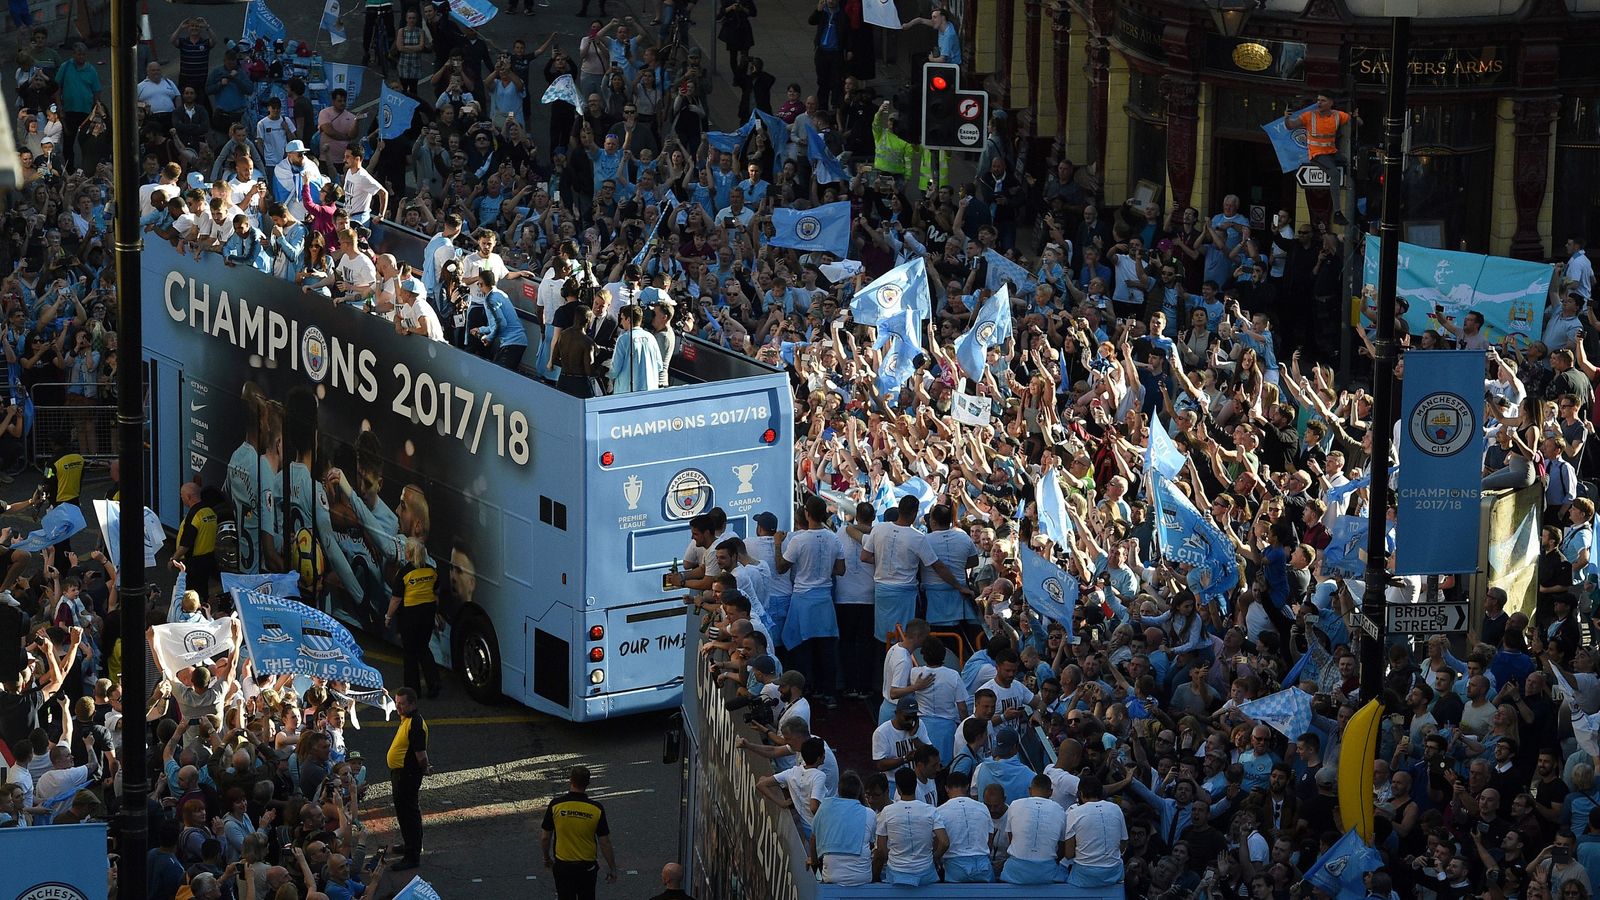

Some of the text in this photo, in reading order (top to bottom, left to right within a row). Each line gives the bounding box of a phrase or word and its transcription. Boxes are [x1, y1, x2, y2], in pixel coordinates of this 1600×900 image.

[1360, 60, 1503, 75] SAERS ARMS
[1310, 171, 1323, 180] WC
[164, 270, 530, 466] CHAMPIONS 2017/18
[1416, 396, 1469, 417] MANCHESTER
[610, 406, 768, 440] CHAMPIONS 2017/18
[1431, 445, 1451, 453] CITY
[671, 470, 706, 490] MANCHESTER
[1401, 488, 1478, 499] CHAMPIONS
[728, 496, 762, 507] CARABAO
[738, 504, 752, 512] CUP
[1415, 500, 1462, 511] 2017/18
[618, 513, 648, 523] PREMIER
[619, 520, 646, 530] LEAGUE
[1177, 547, 1207, 563] CITY
[1394, 606, 1446, 618] BRIDGE
[618, 638, 650, 656] OUR
[262, 657, 380, 682] THE CITY IS OURS!
[696, 639, 756, 839] CHAMPIONS
